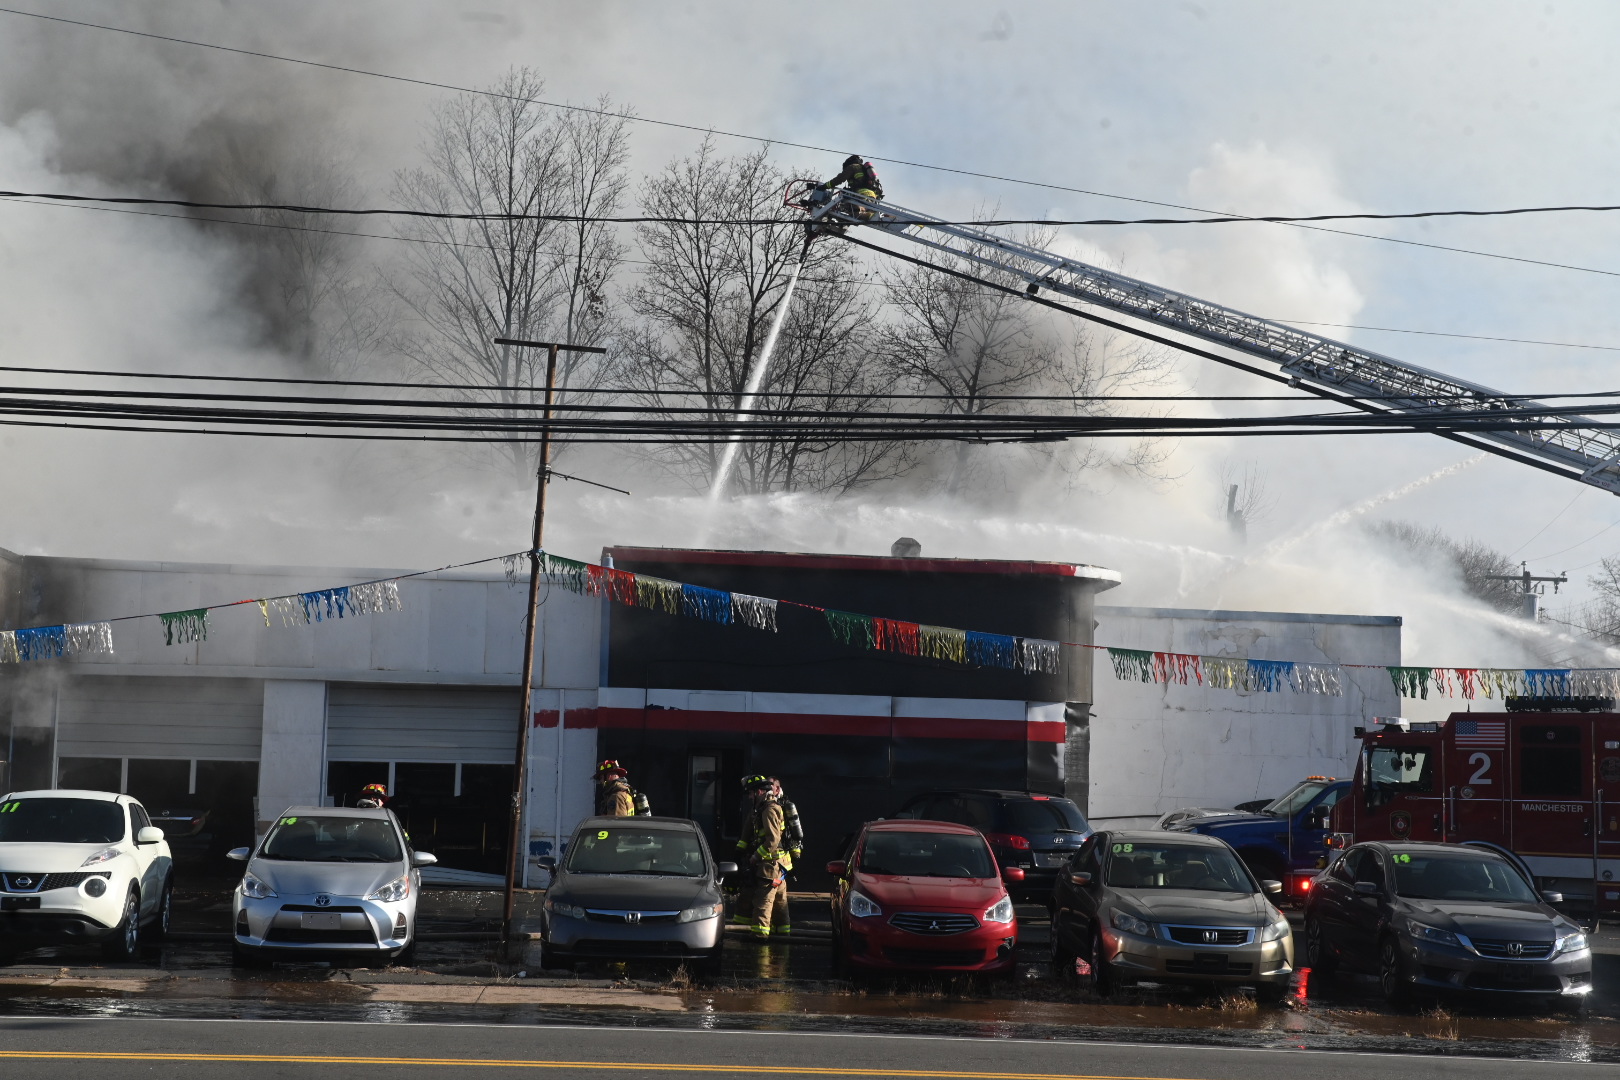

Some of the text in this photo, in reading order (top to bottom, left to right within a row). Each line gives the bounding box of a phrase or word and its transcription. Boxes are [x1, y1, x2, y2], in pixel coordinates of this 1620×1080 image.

[1468, 752, 1492, 785] 2
[1, 802, 21, 813] 11
[1521, 803, 1584, 813] MANCHESTER
[597, 830, 609, 840] 9
[1112, 843, 1133, 853] 08
